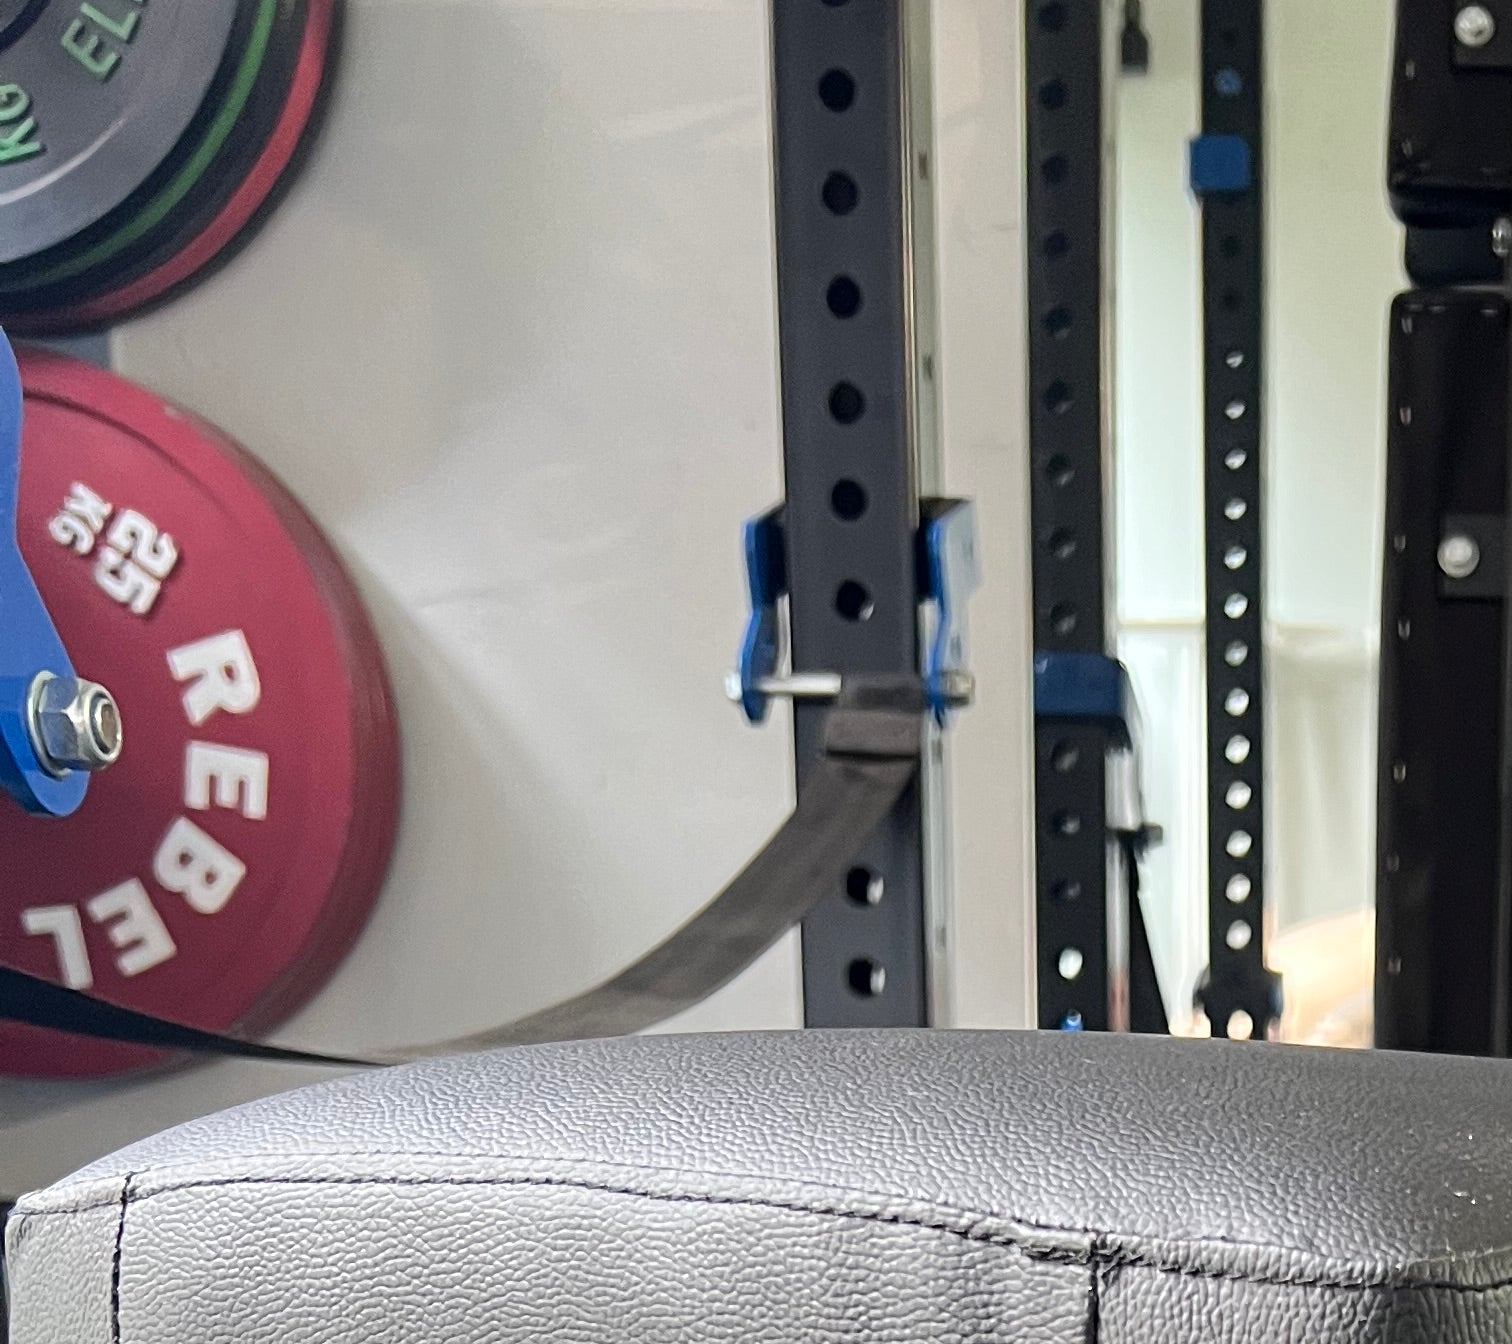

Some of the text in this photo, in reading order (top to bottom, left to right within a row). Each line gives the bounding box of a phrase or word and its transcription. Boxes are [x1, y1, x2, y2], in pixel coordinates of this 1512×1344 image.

[61, 0, 143, 79] EL
[49, 481, 113, 555] KG
[94, 509, 178, 614] 25
[22, 629, 269, 991] REBEL
